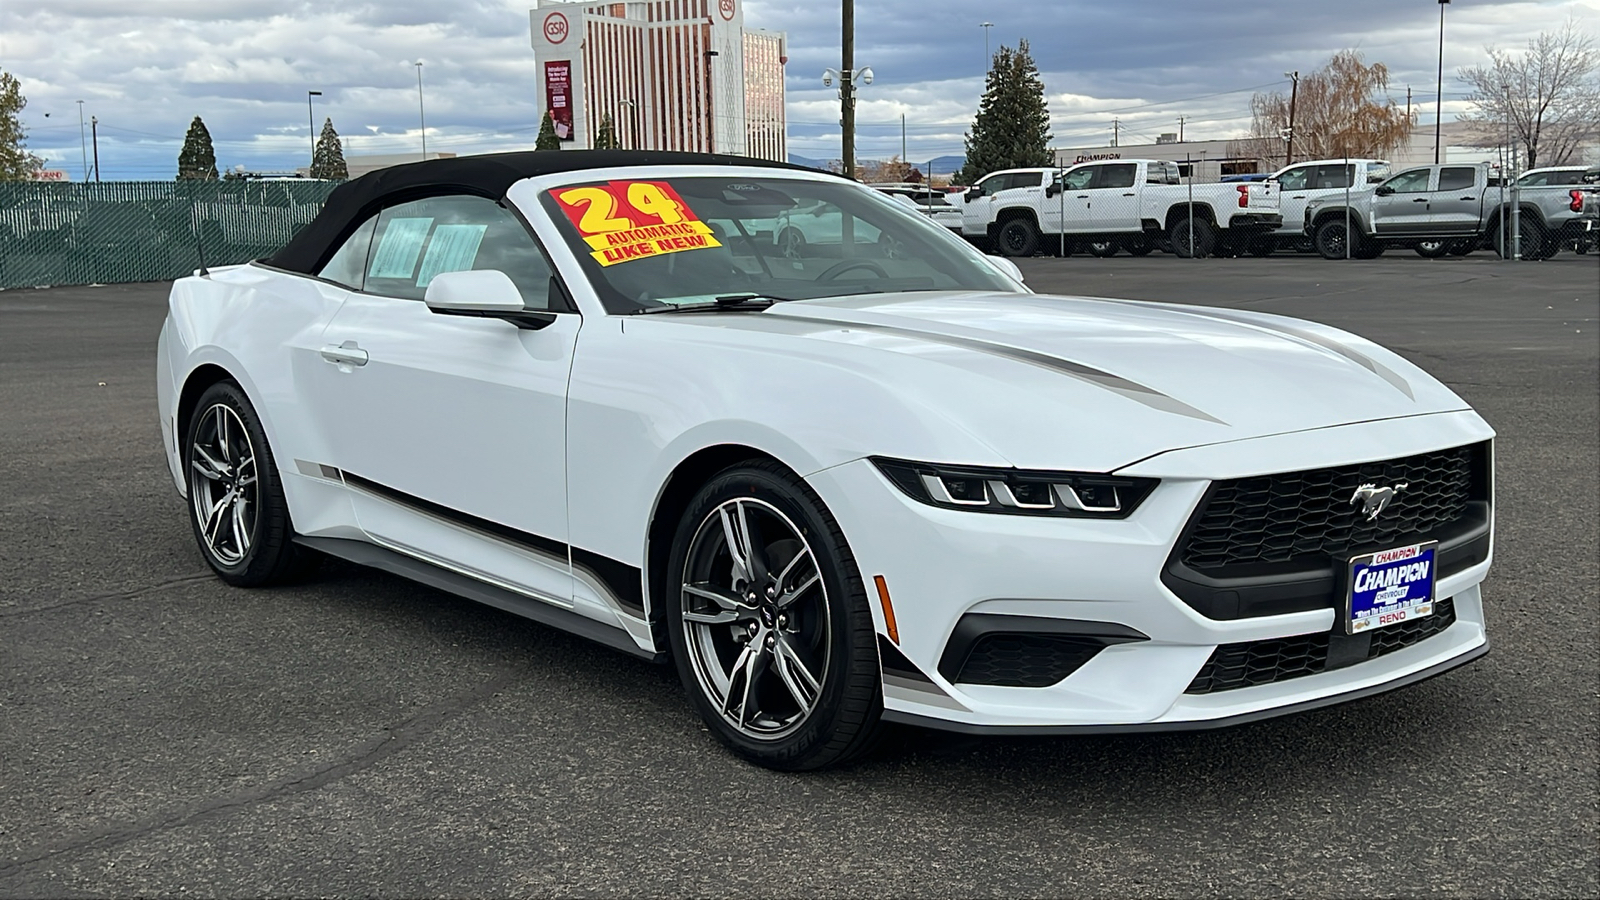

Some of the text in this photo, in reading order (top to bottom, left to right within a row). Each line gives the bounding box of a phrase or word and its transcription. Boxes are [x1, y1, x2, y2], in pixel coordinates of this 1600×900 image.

[546, 22, 566, 35] GSR
[1077, 153, 1121, 164] CHAMPION
[559, 182, 686, 234] 24
[606, 222, 696, 246] AUTOMATIC
[602, 235, 708, 263] LIKE NEW
[1375, 547, 1417, 564] CHAMPION
[1354, 561, 1430, 593] CHAMPION
[1376, 588, 1407, 600] CHEVROLET
[1379, 611, 1406, 625] RENO
